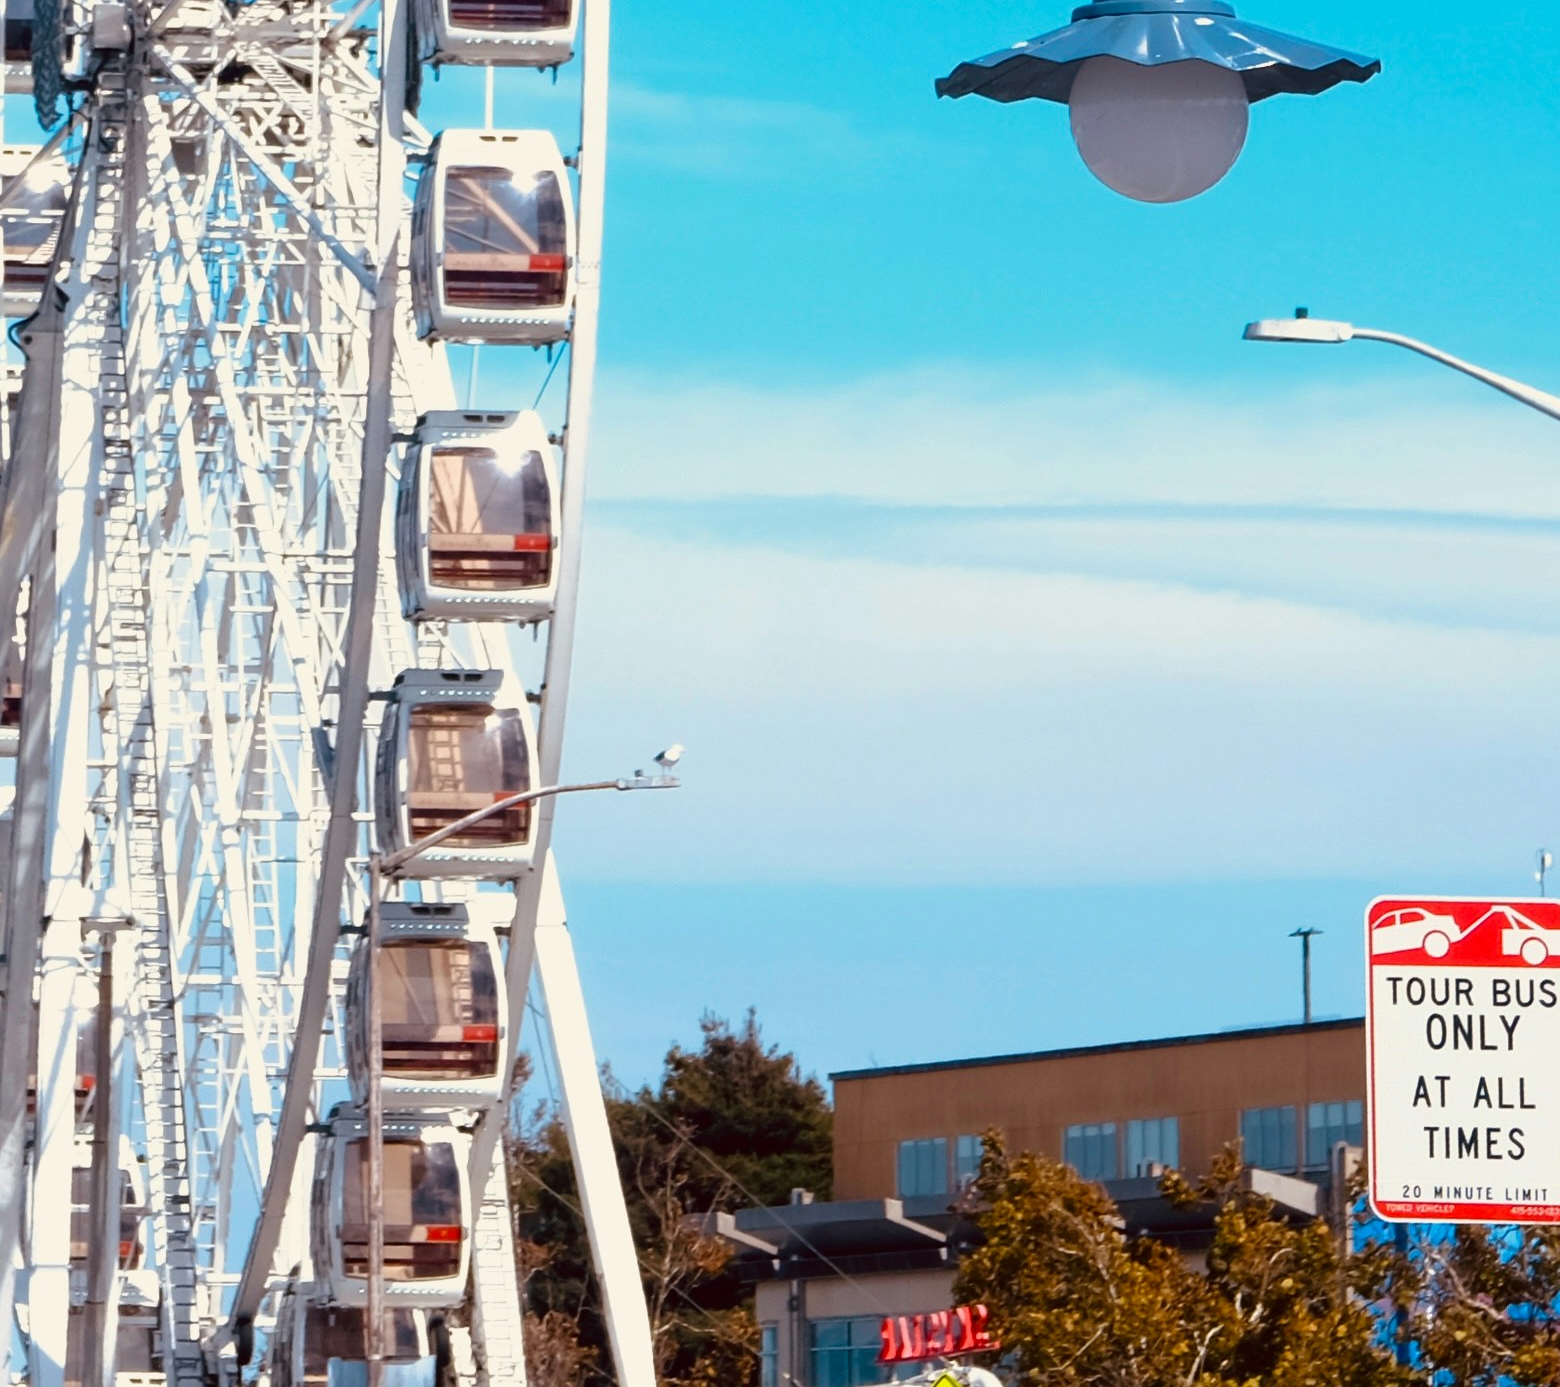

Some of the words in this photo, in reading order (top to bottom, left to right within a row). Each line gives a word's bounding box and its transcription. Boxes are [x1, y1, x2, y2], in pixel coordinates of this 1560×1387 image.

[1386, 976, 1475, 1007] TOUR
[1492, 978, 1558, 1008] BUS
[1426, 1013, 1521, 1051] ONLY
[1412, 1075, 1451, 1108] AT
[1473, 1076, 1537, 1109] ALL
[1423, 1126, 1527, 1161] TIMES
[1402, 1184, 1422, 1199] 20
[1433, 1185, 1494, 1201] MINUTE
[1505, 1187, 1549, 1202] LIMIT
